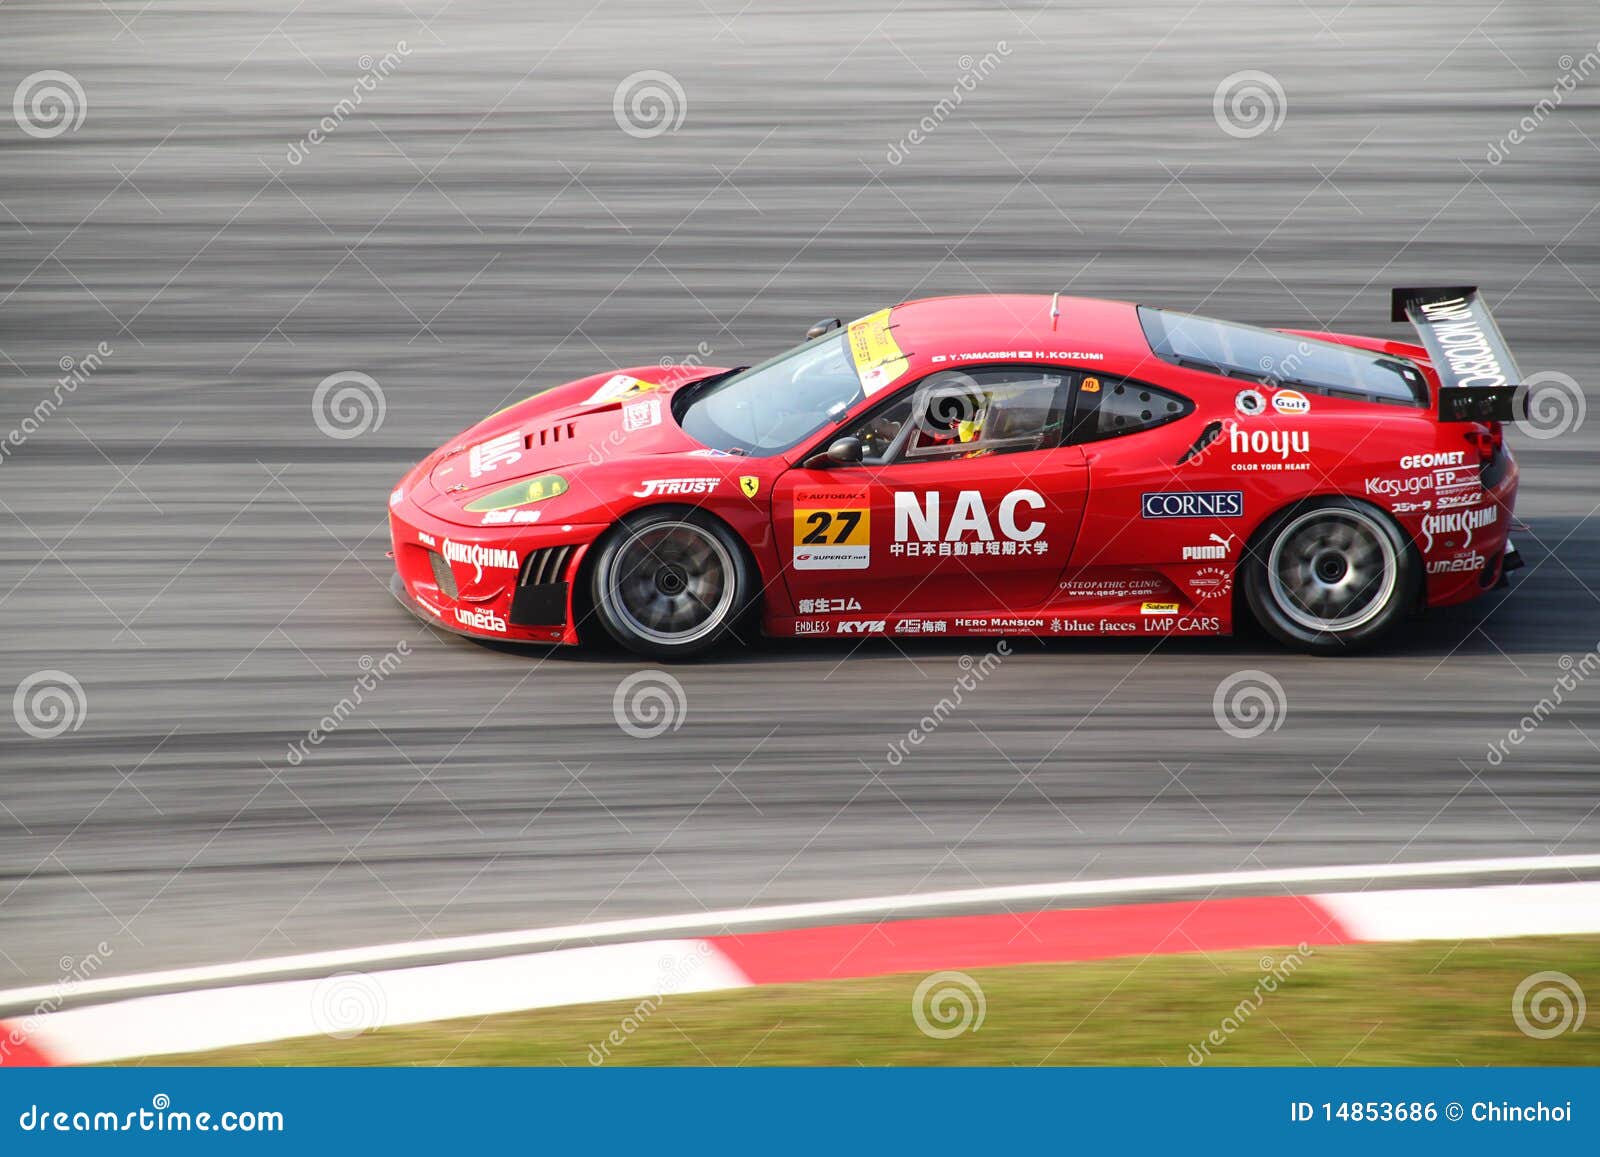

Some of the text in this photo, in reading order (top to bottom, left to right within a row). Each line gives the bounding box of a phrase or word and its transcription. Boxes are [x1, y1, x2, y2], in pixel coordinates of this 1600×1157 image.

[1432, 321, 1508, 388] MOTORSPO
[1275, 398, 1307, 409] Gulf
[1230, 422, 1310, 459] hoyu
[1400, 451, 1464, 469] GEOMET
[1365, 474, 1433, 496] Kasugai
[1146, 495, 1239, 515] CORNES
[894, 489, 1046, 542] NAC
[802, 511, 862, 544] 27
[1421, 505, 1497, 553] SHIKISHIMA
[890, 540, 1048, 557] 中日本自動車短期大学
[1182, 545, 1226, 560] PUMA
[1060, 580, 1161, 589] OSTEOPATHIC CLINIC
[799, 597, 862, 613] 衛生コム
[795, 620, 830, 634] ENDLESS
[836, 620, 887, 633] KYB
[955, 618, 1044, 627] HERO MANSION
[1064, 619, 1137, 632] blue faces
[1144, 617, 1220, 632] LMP CARS
